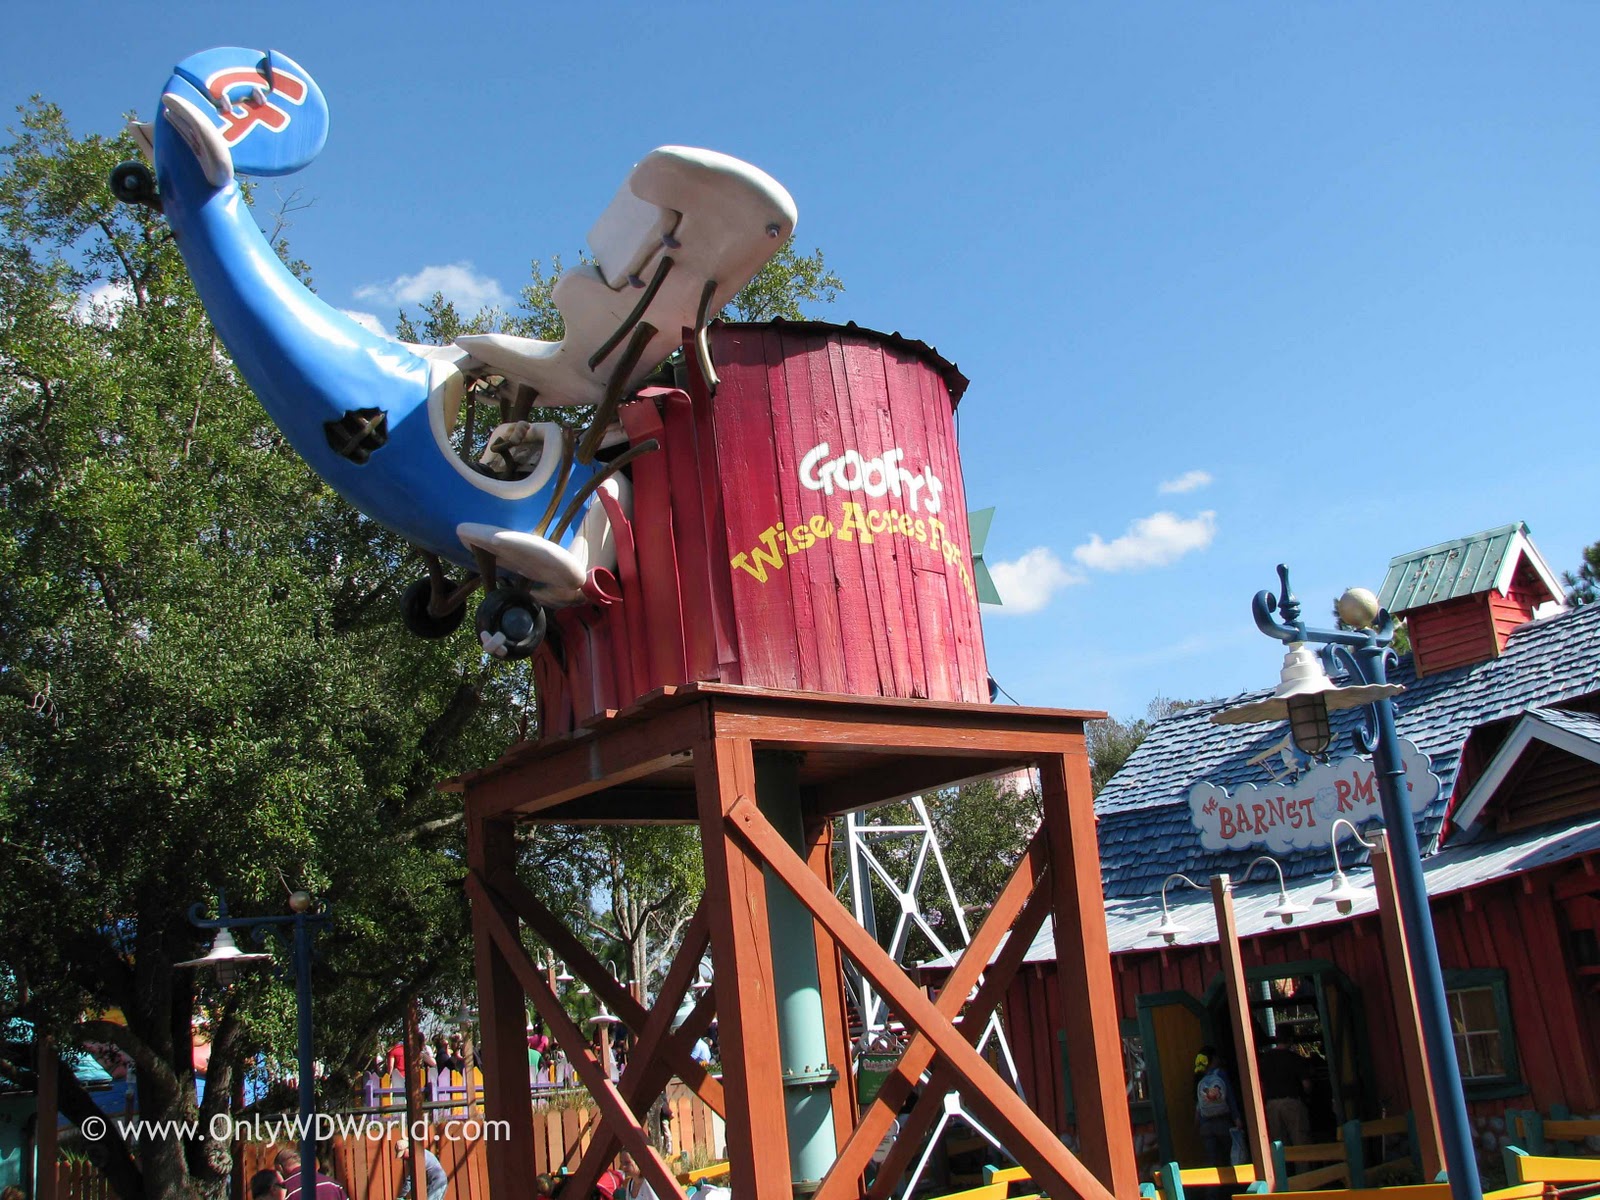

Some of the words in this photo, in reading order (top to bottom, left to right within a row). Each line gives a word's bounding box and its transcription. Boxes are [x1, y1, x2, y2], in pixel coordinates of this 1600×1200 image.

[730, 514, 834, 583] Wise
[836, 501, 928, 544] Acres
[1201, 796, 1219, 816] THE
[1219, 758, 1413, 839] BARNSTORM
